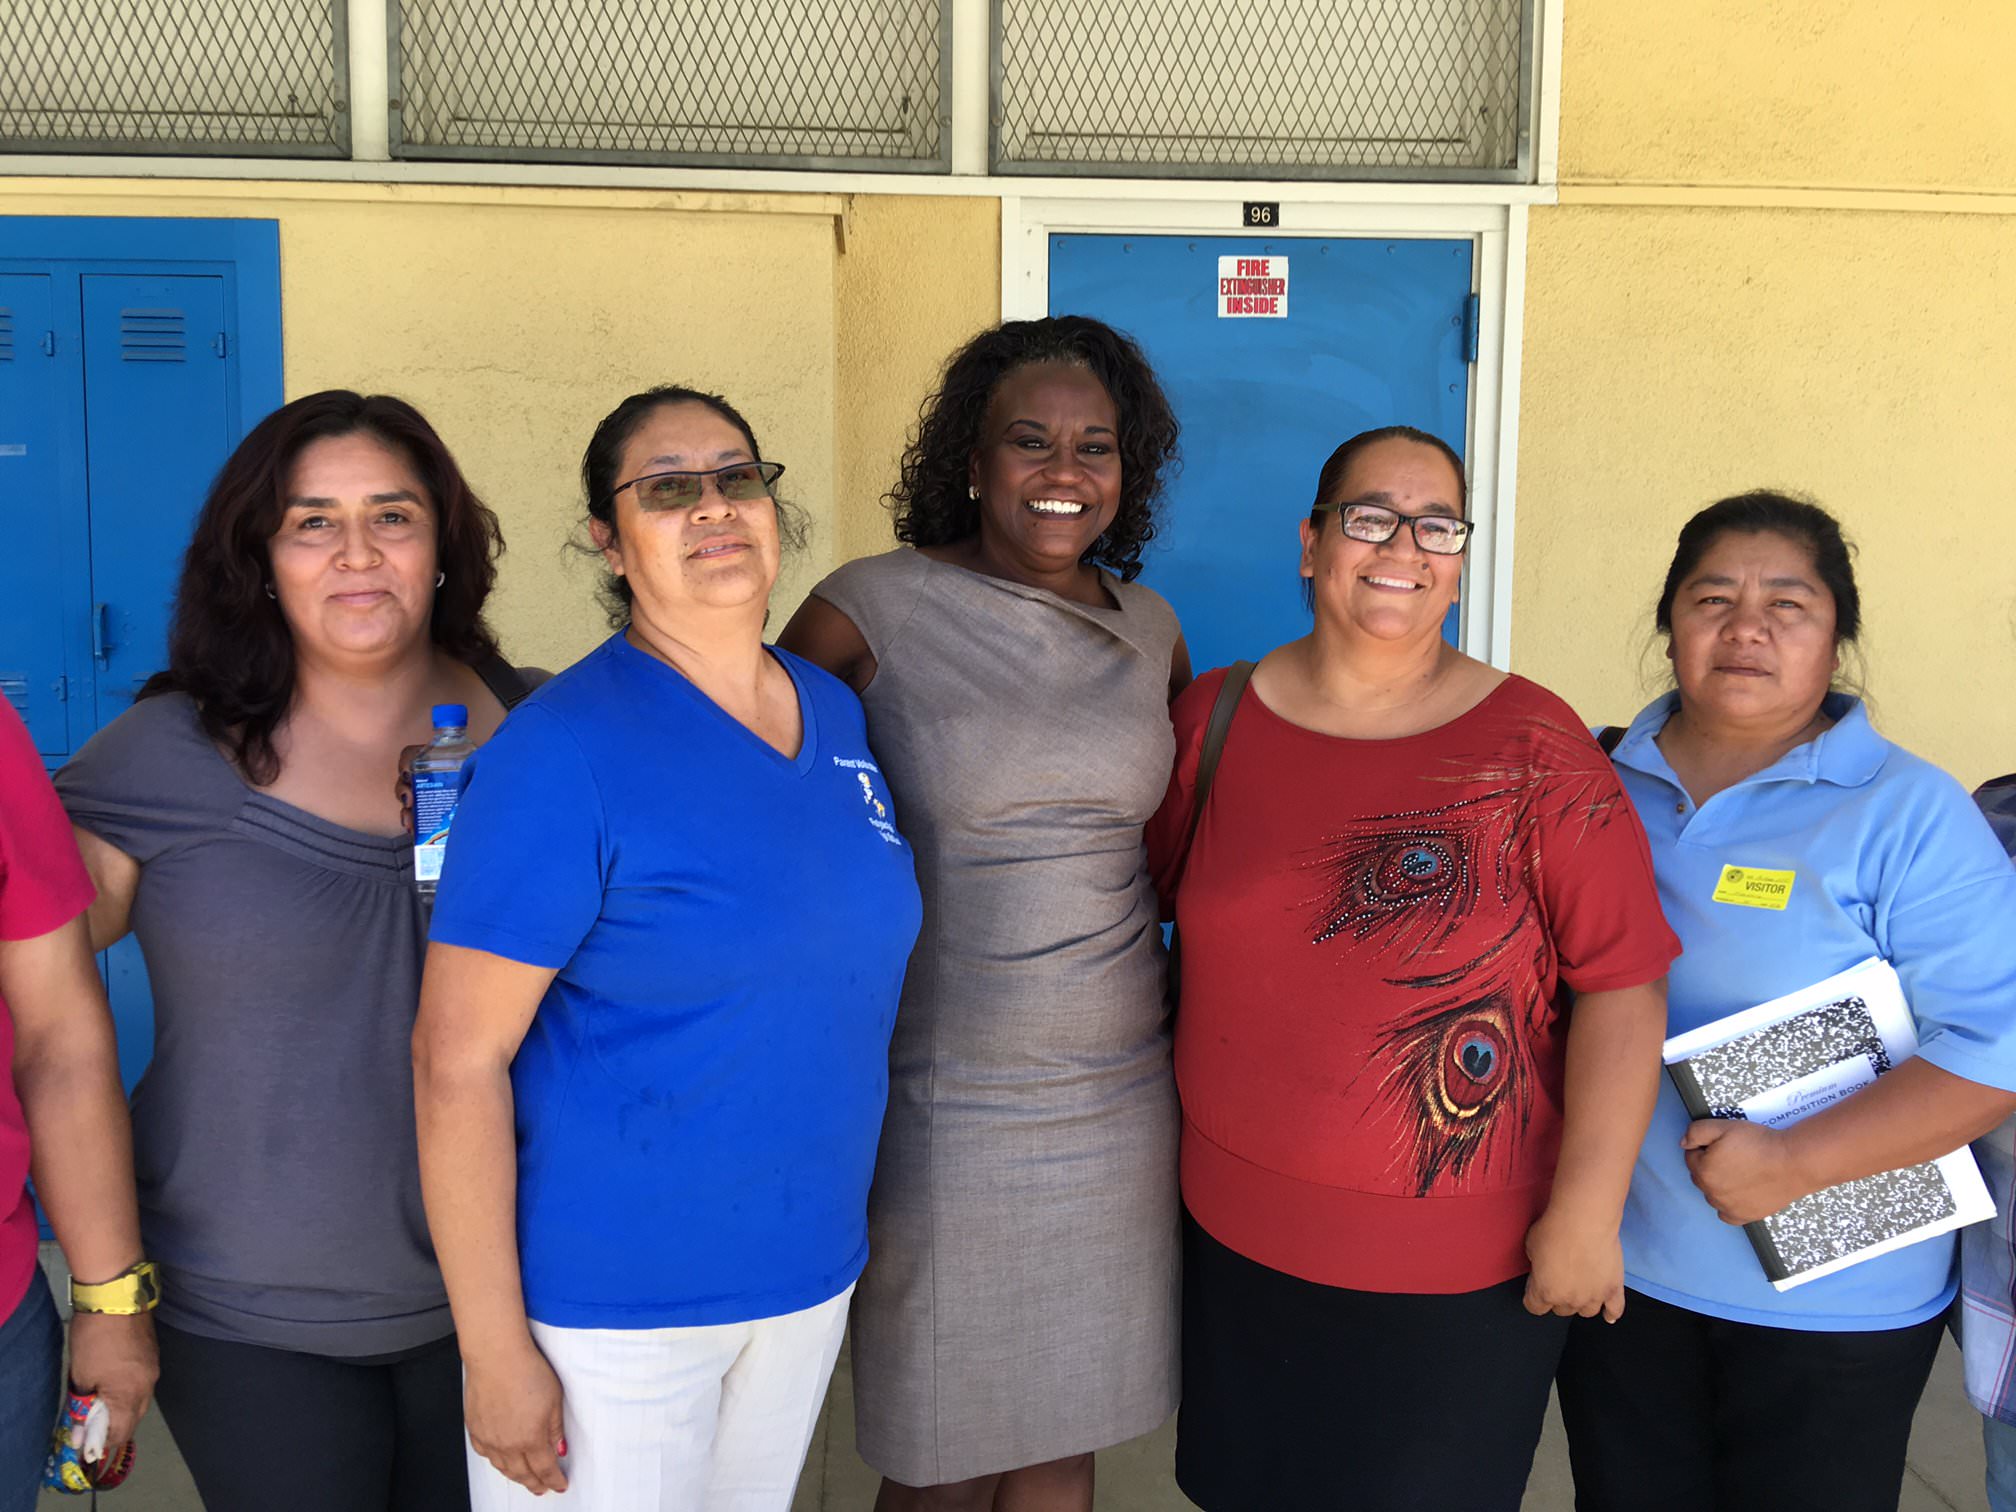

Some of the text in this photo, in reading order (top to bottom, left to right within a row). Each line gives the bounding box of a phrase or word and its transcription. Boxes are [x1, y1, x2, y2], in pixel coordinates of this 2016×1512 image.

[1251, 206, 1271, 223] 96
[1237, 259, 1270, 276] FIRE
[1220, 278, 1285, 296] EXTINGUISHER
[1227, 297, 1279, 314] INSIDE
[1745, 881, 1786, 895] VISITOR
[1760, 1079, 1870, 1127] COMPOSITION BOOK
[1786, 1083, 1837, 1106] Premium
